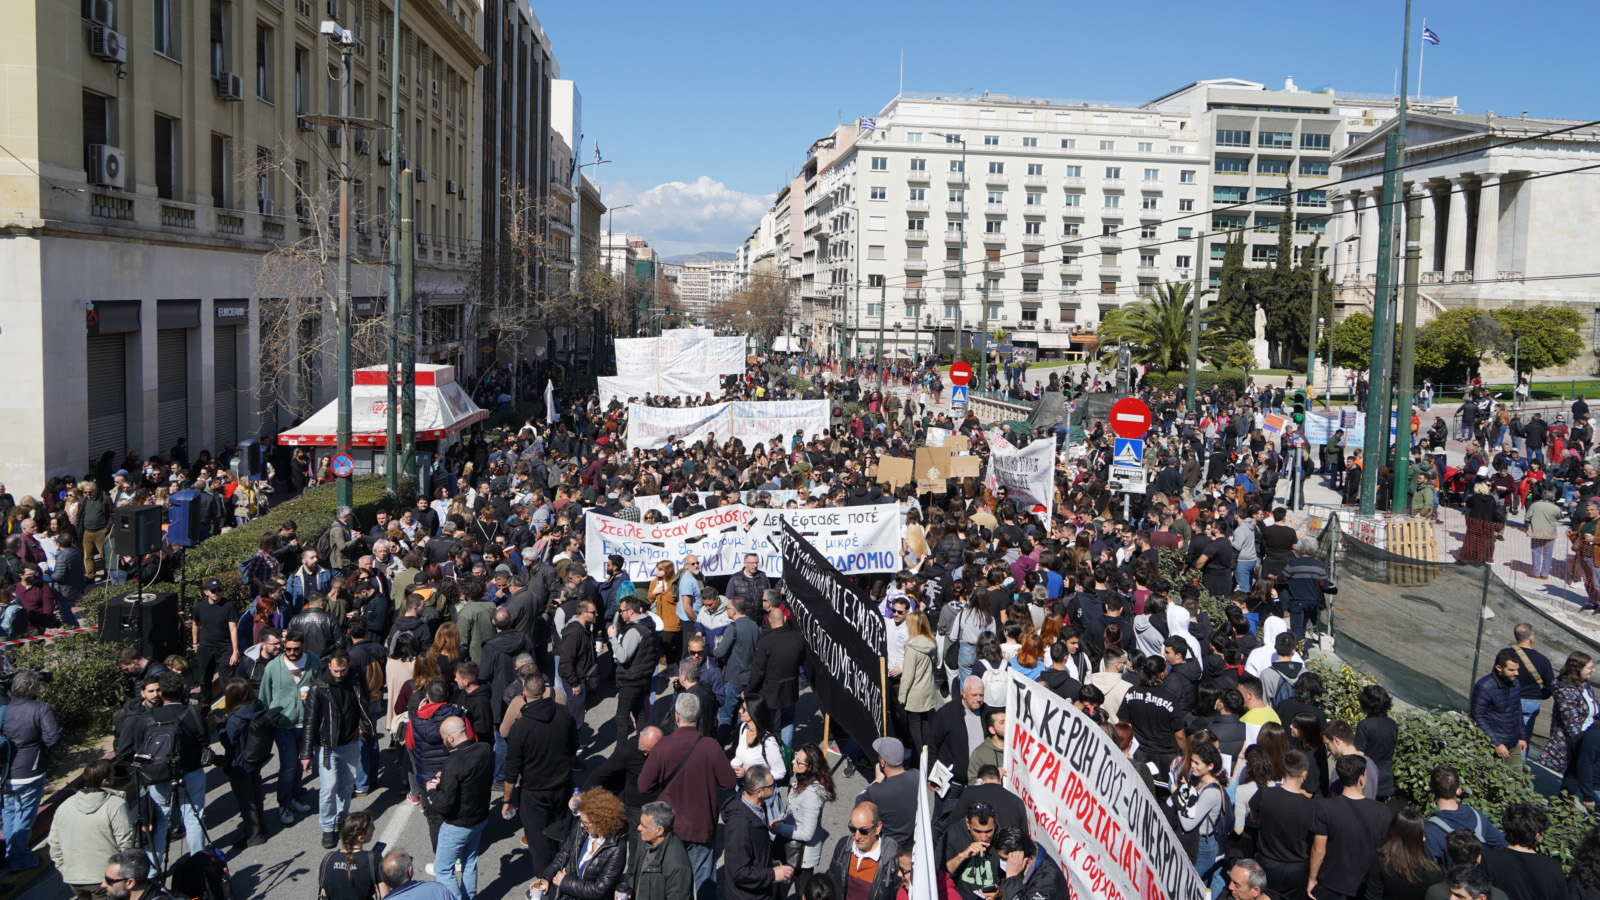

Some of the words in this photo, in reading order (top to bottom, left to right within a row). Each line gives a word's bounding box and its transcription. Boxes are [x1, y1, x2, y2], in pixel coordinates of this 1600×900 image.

[218, 307, 245, 317] EUROBANK
[651, 522, 689, 539] όταν
[848, 506, 879, 524] ποτέ
[602, 540, 669, 560] Εκδίκηση
[751, 539, 768, 550] για
[1125, 690, 1144, 704] Palm
[1145, 692, 1174, 713] Angels
[1012, 679, 1034, 731] ΤΑ
[1039, 699, 1100, 778] ΚΕΡΔΗ
[1010, 757, 1020, 794] Για
[1012, 723, 1061, 793] ΜΕΤΡΑ
[1061, 770, 1141, 892] ΠΡΟΣΤΑΣΙΑΣ
